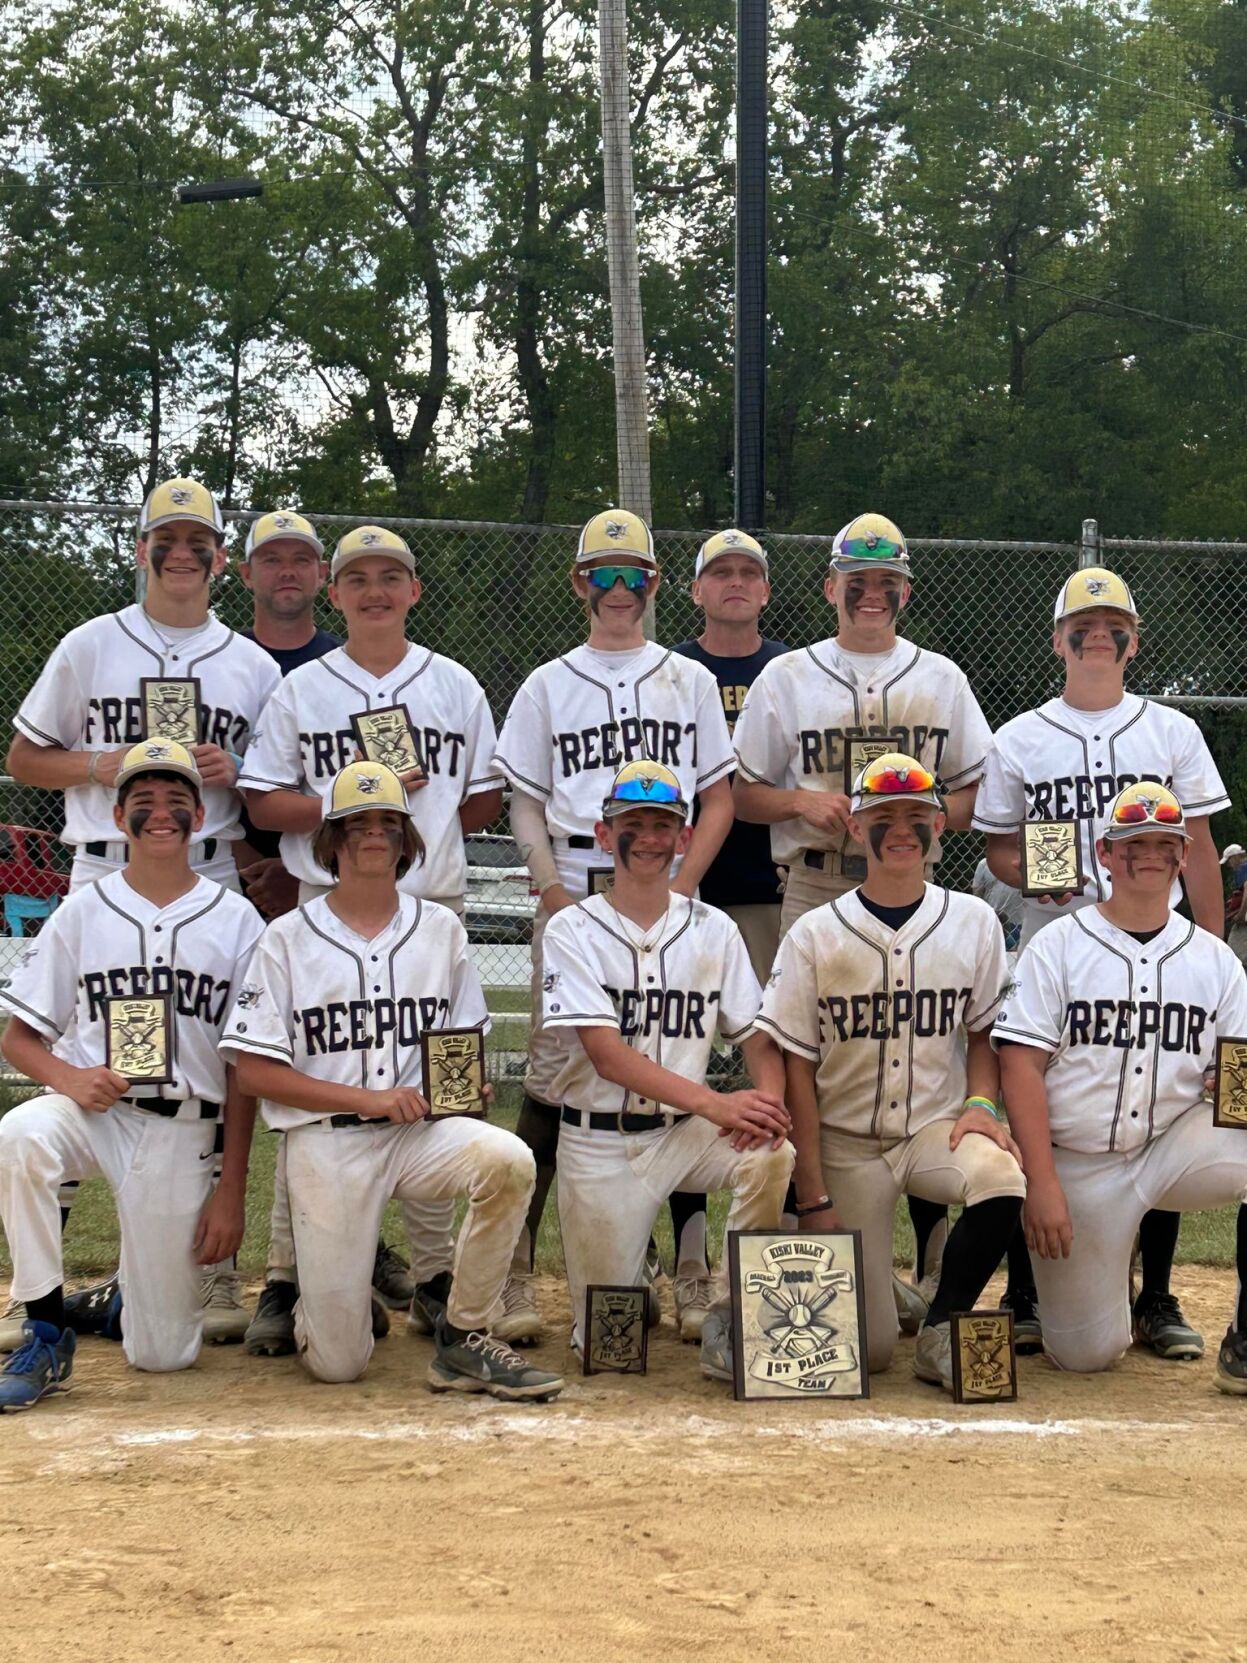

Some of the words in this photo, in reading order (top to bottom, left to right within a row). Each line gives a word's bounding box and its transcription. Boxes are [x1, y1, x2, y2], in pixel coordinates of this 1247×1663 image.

[793, 1243, 825, 1259] VALLEY
[766, 1361, 791, 1376] 1ST
[798, 1348, 838, 1371] PLACE
[799, 1378, 826, 1388] TEAM
